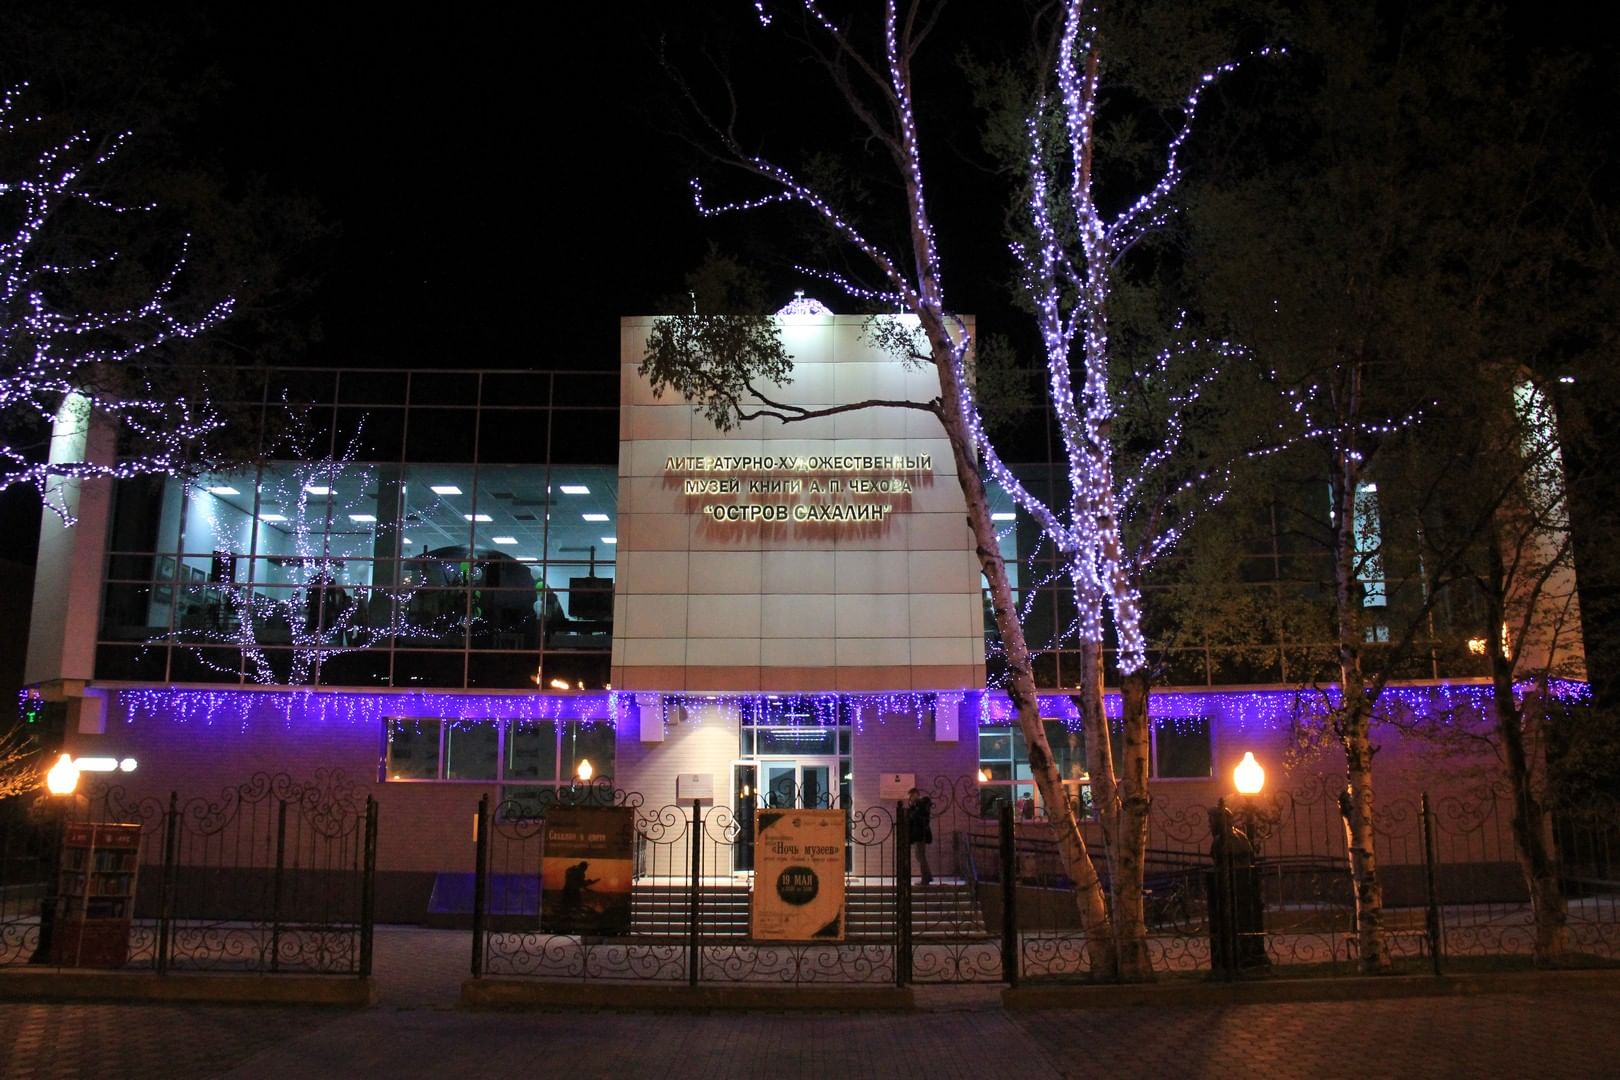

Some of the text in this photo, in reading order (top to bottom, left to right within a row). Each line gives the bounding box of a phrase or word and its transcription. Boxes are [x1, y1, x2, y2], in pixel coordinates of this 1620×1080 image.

[665, 453, 931, 470] ЛИТЕРАТУРНО-ХУДОЖЕСТВЕННЫЙ
[685, 478, 740, 493] МУЗЕЙ
[750, 480, 800, 493] КНИГИ
[849, 480, 911, 493] ЧЕХОВА
[772, 842, 839, 857] «Ночь музеев»
[795, 874, 813, 886] МАЯ
